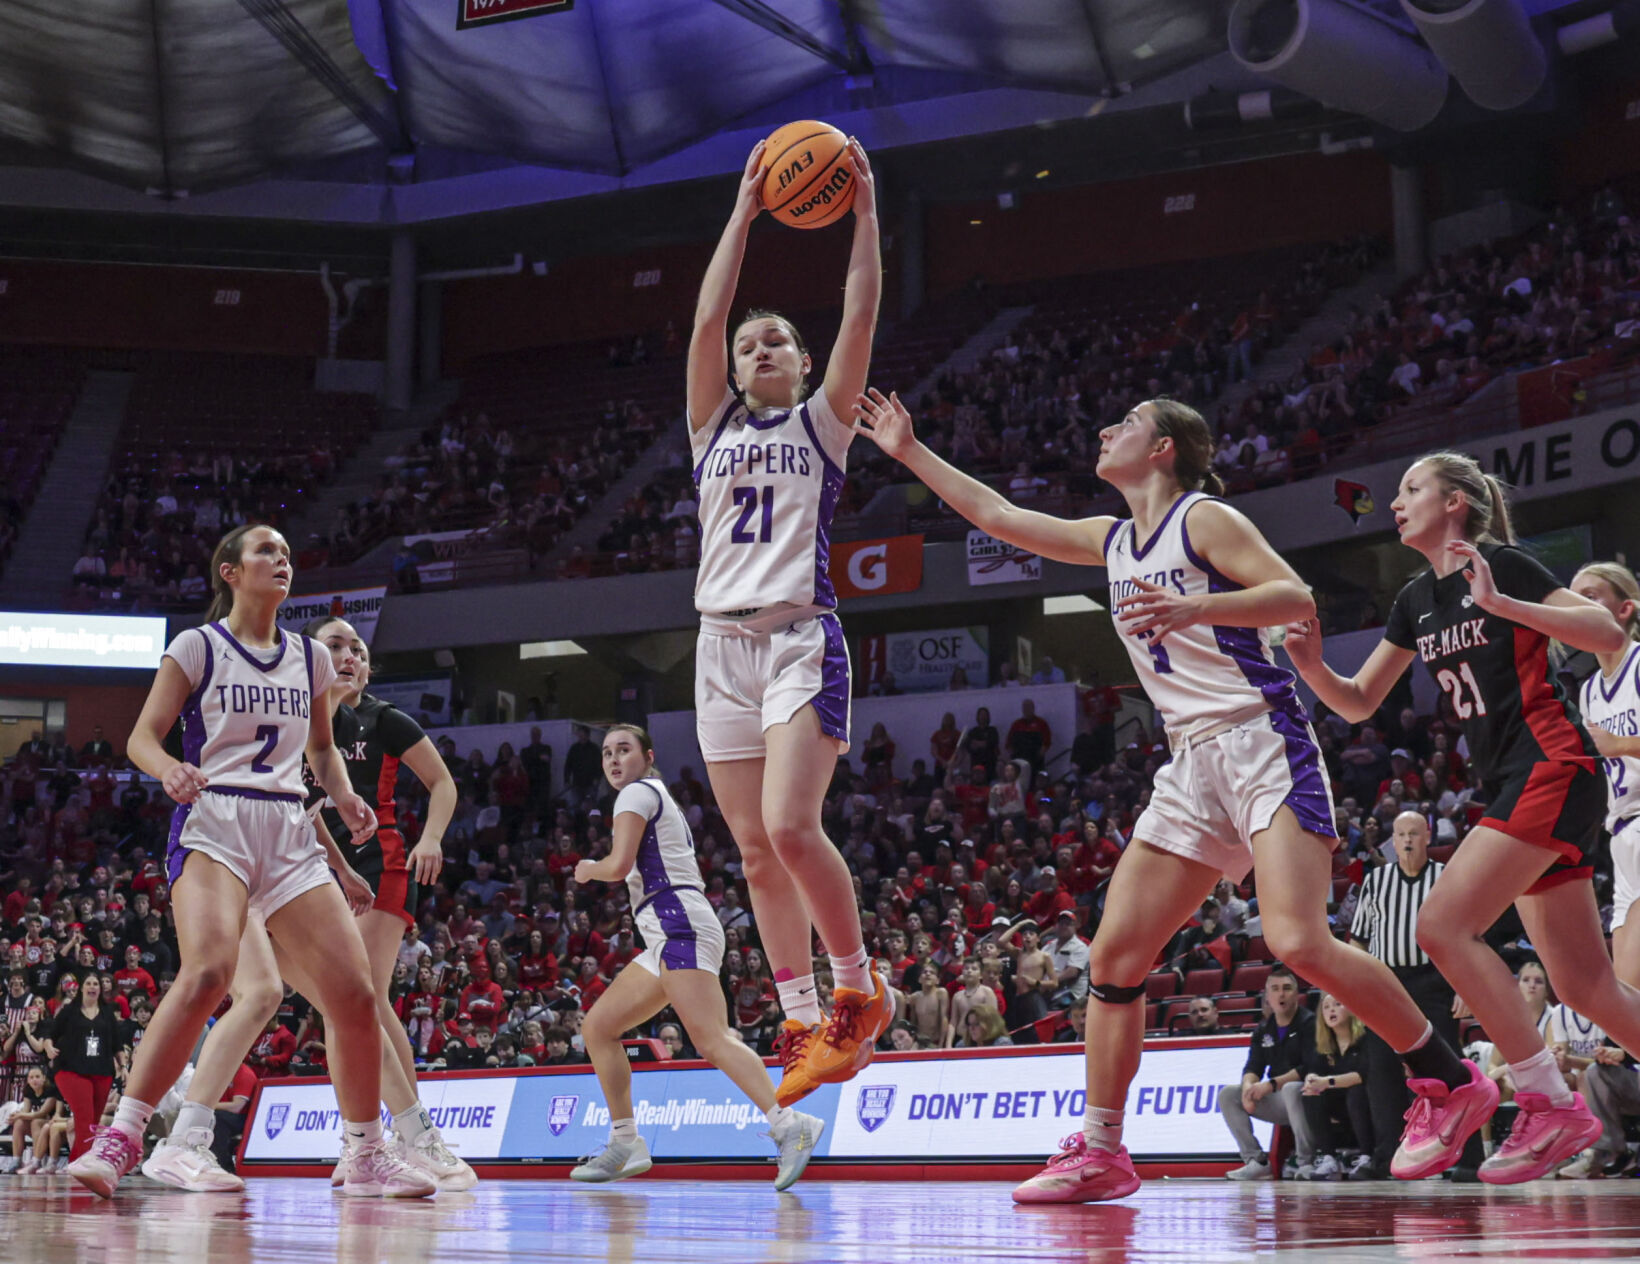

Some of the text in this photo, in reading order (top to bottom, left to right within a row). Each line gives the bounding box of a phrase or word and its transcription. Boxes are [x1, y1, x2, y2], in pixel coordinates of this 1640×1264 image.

[789, 167, 851, 217] Wilson
[707, 443, 810, 479] TOPPERS
[1471, 432, 1573, 489] ME
[731, 485, 774, 544] 21
[847, 543, 887, 590] G
[918, 635, 962, 661] OSF
[1416, 618, 1489, 662] EE-MACK
[216, 684, 310, 719] TOPPERS
[1436, 661, 1487, 720] 21
[251, 725, 279, 773] 2
[294, 1110, 340, 1131] DON'T
[428, 1105, 496, 1128] FUTURE
[908, 1084, 1226, 1120] DON'T BET YO FUTU
